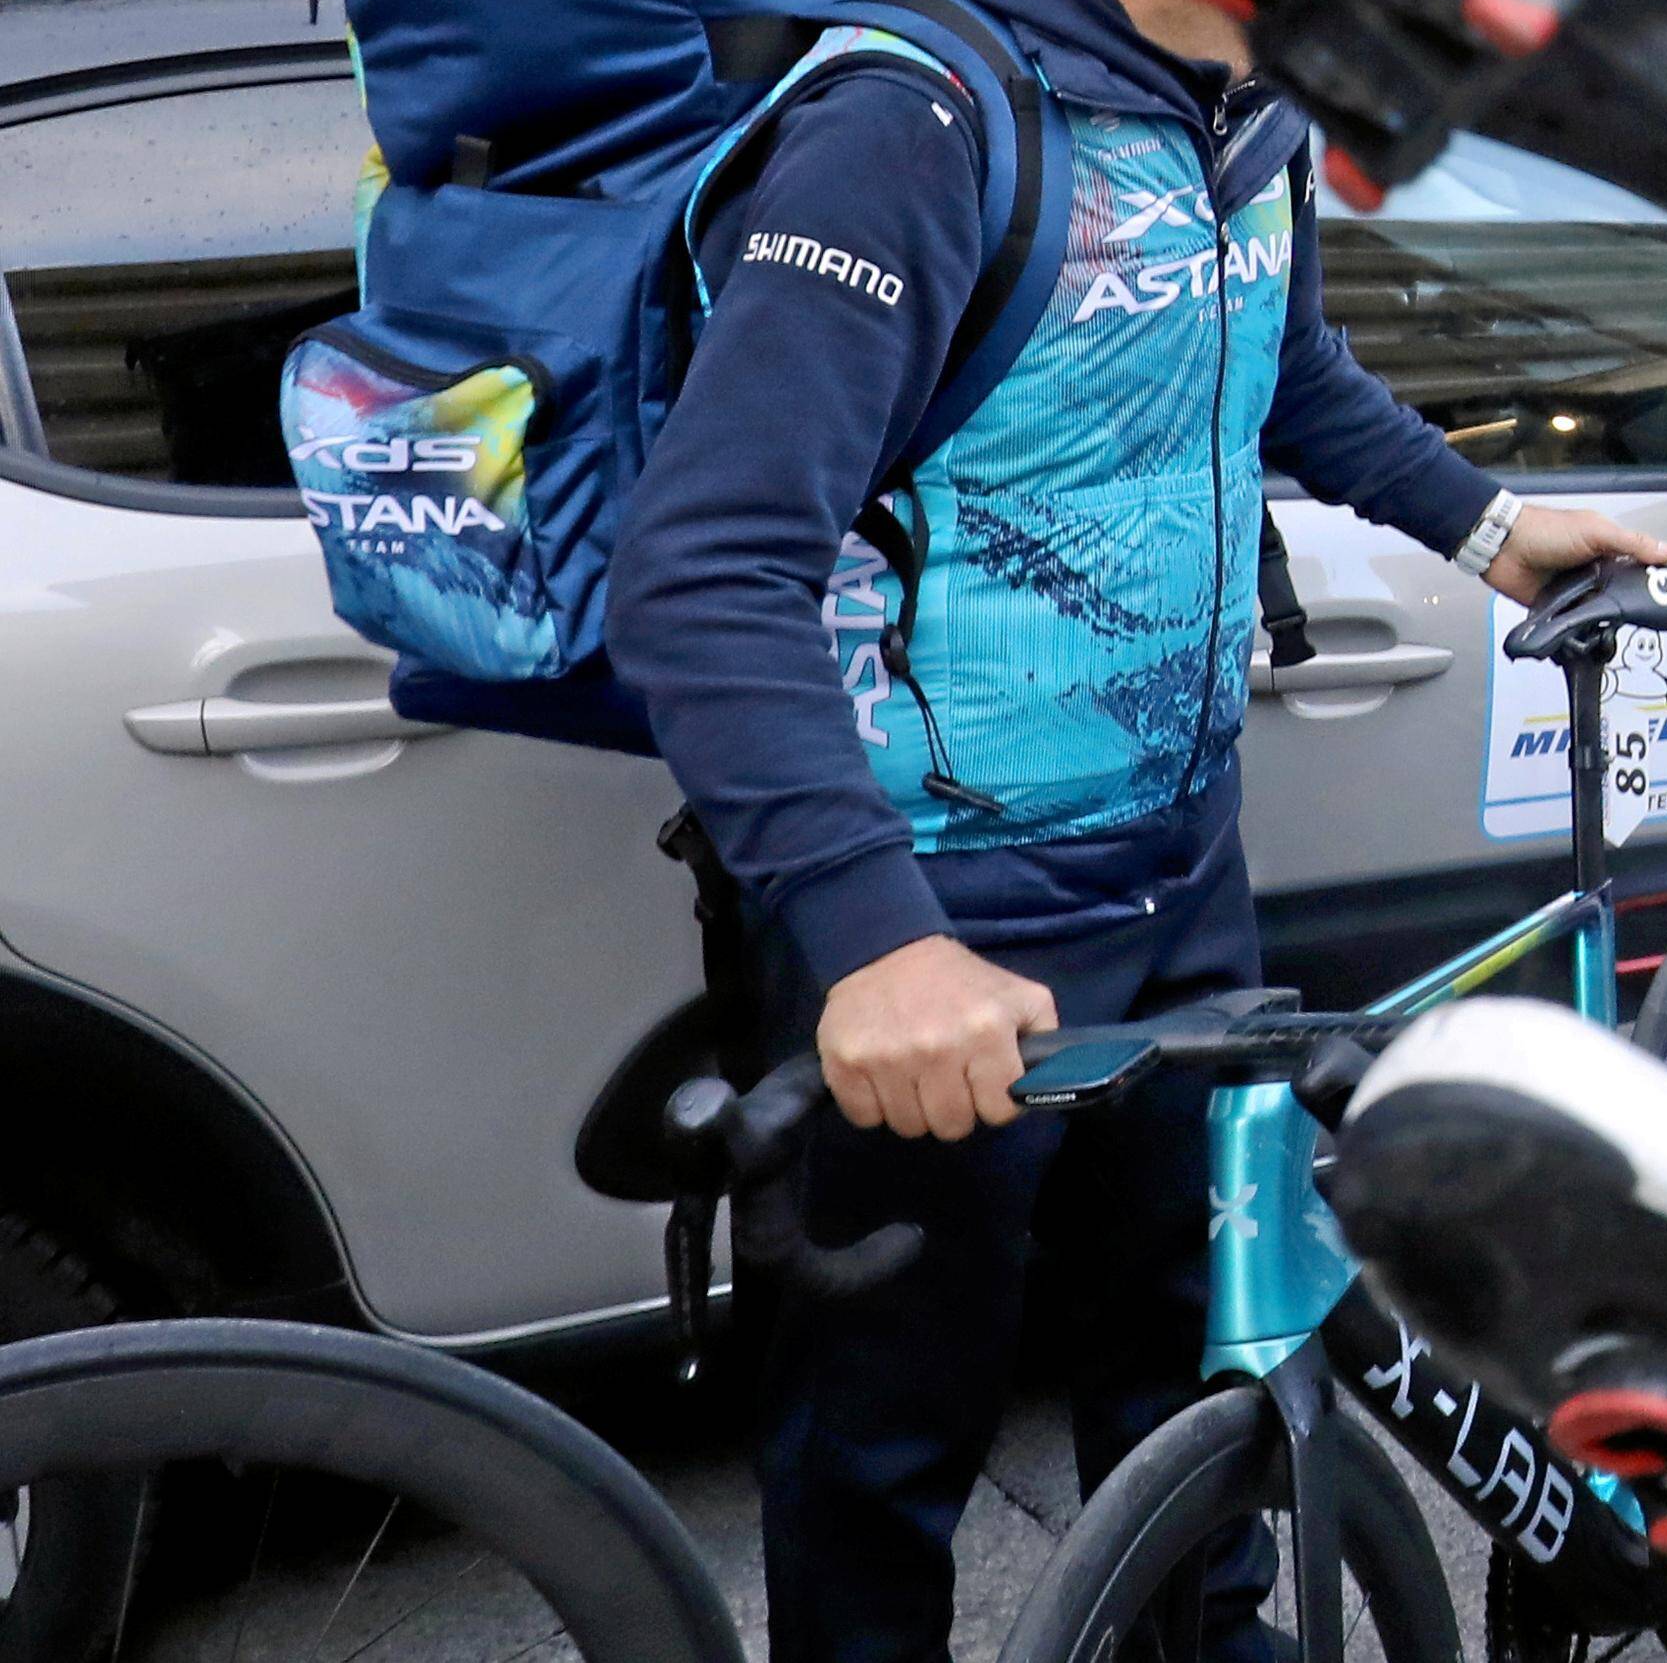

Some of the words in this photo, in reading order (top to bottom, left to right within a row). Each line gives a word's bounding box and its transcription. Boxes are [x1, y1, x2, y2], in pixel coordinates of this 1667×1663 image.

[742, 232, 905, 307] SHIMANO
[1071, 229, 1292, 324] ASTANA
[301, 487, 507, 536] STANA
[345, 538, 406, 555] TEAM
[1615, 731, 1647, 797] 85
[1362, 1308, 1575, 1564] X-LAB
